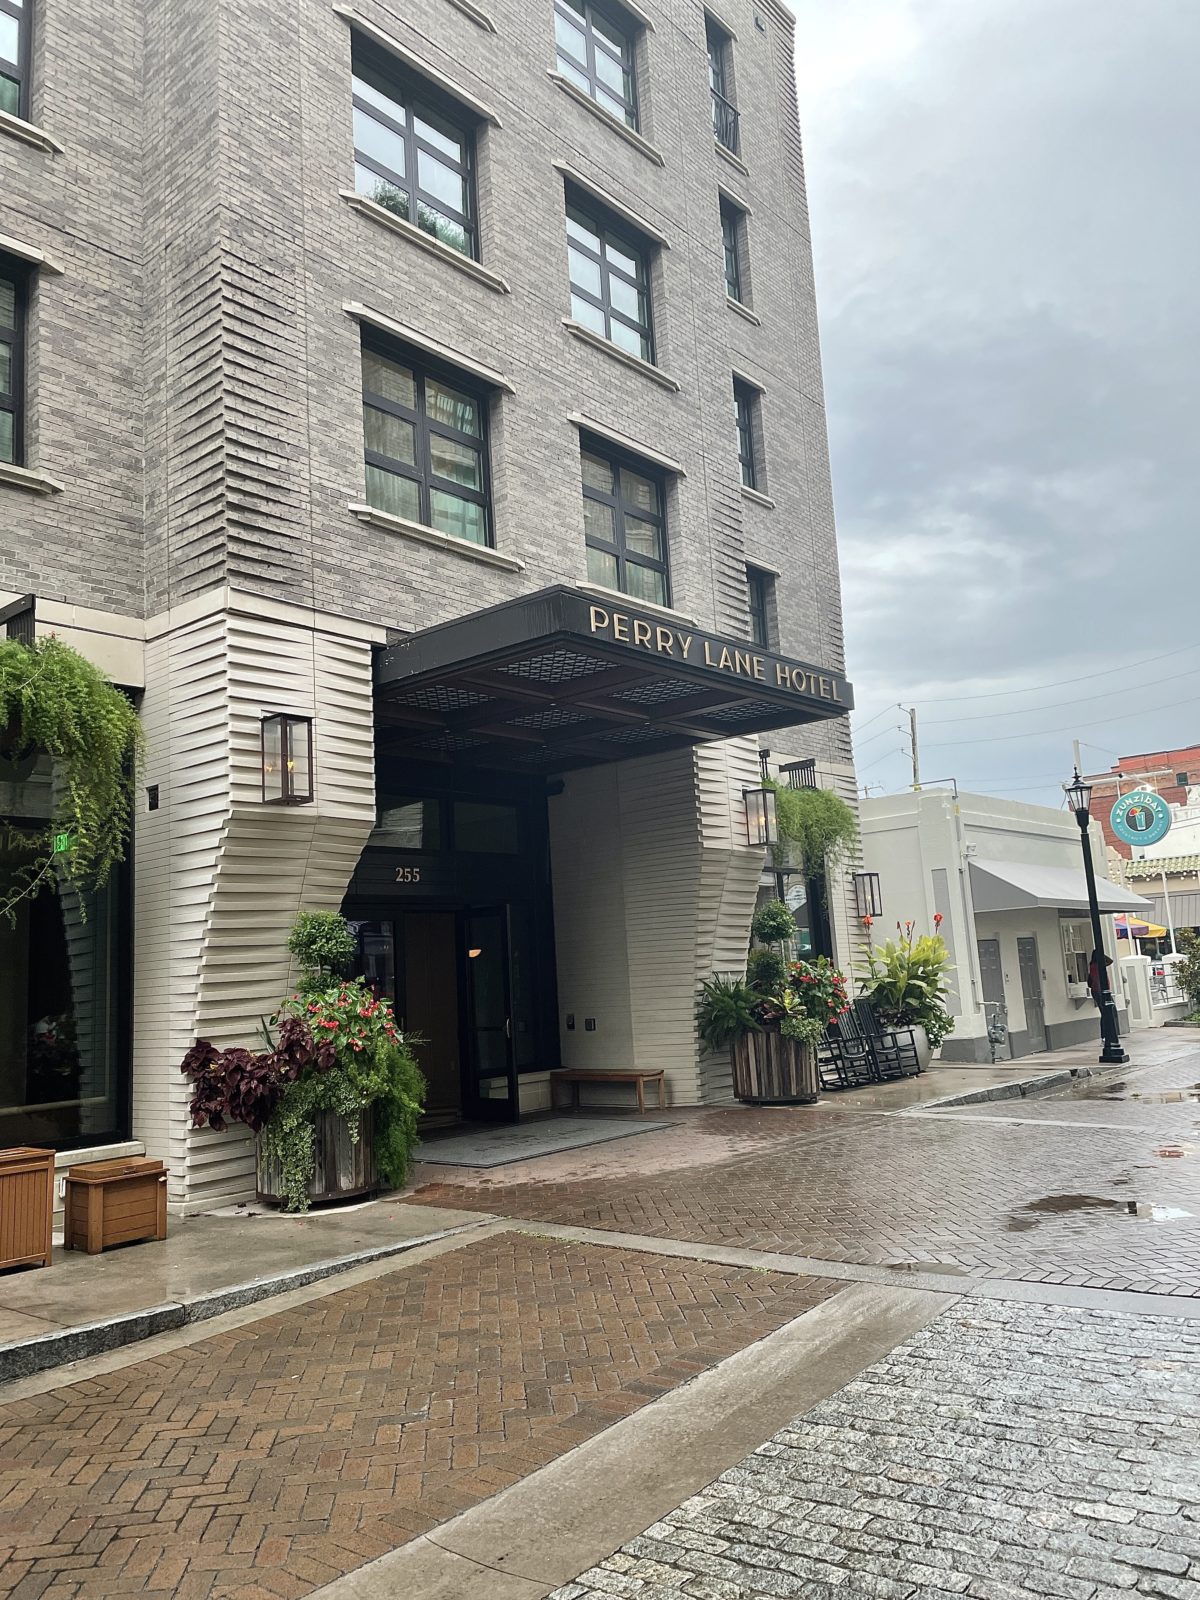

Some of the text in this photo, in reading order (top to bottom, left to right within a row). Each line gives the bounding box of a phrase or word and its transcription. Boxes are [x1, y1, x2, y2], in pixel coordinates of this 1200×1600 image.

[589, 605, 843, 702] PERRY LANE HOTEL
[395, 867, 420, 882] 255
